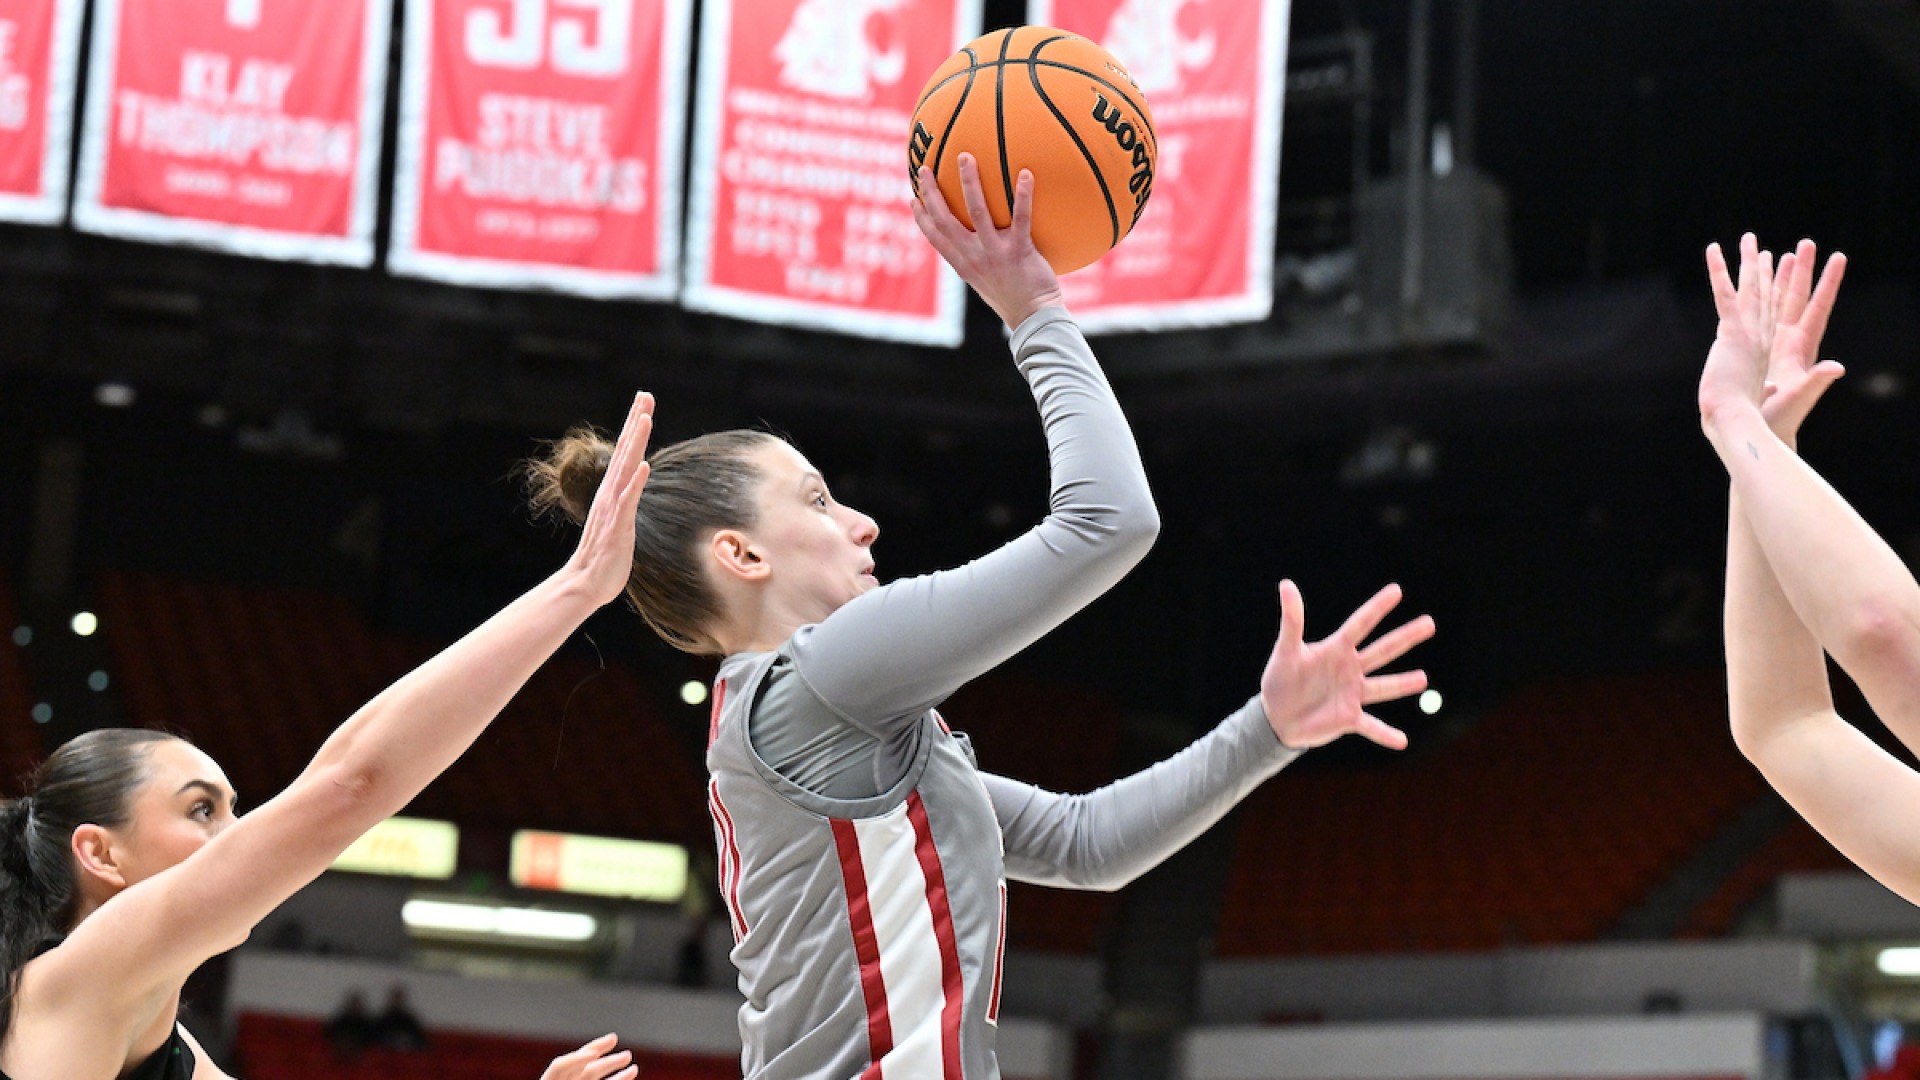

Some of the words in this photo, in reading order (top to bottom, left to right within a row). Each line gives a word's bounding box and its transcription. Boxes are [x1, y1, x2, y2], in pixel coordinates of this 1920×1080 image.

[181, 53, 295, 106] KLAY
[117, 89, 351, 175] THOMPSON
[478, 93, 608, 151] STEVE
[1092, 92, 1152, 232] ilson
